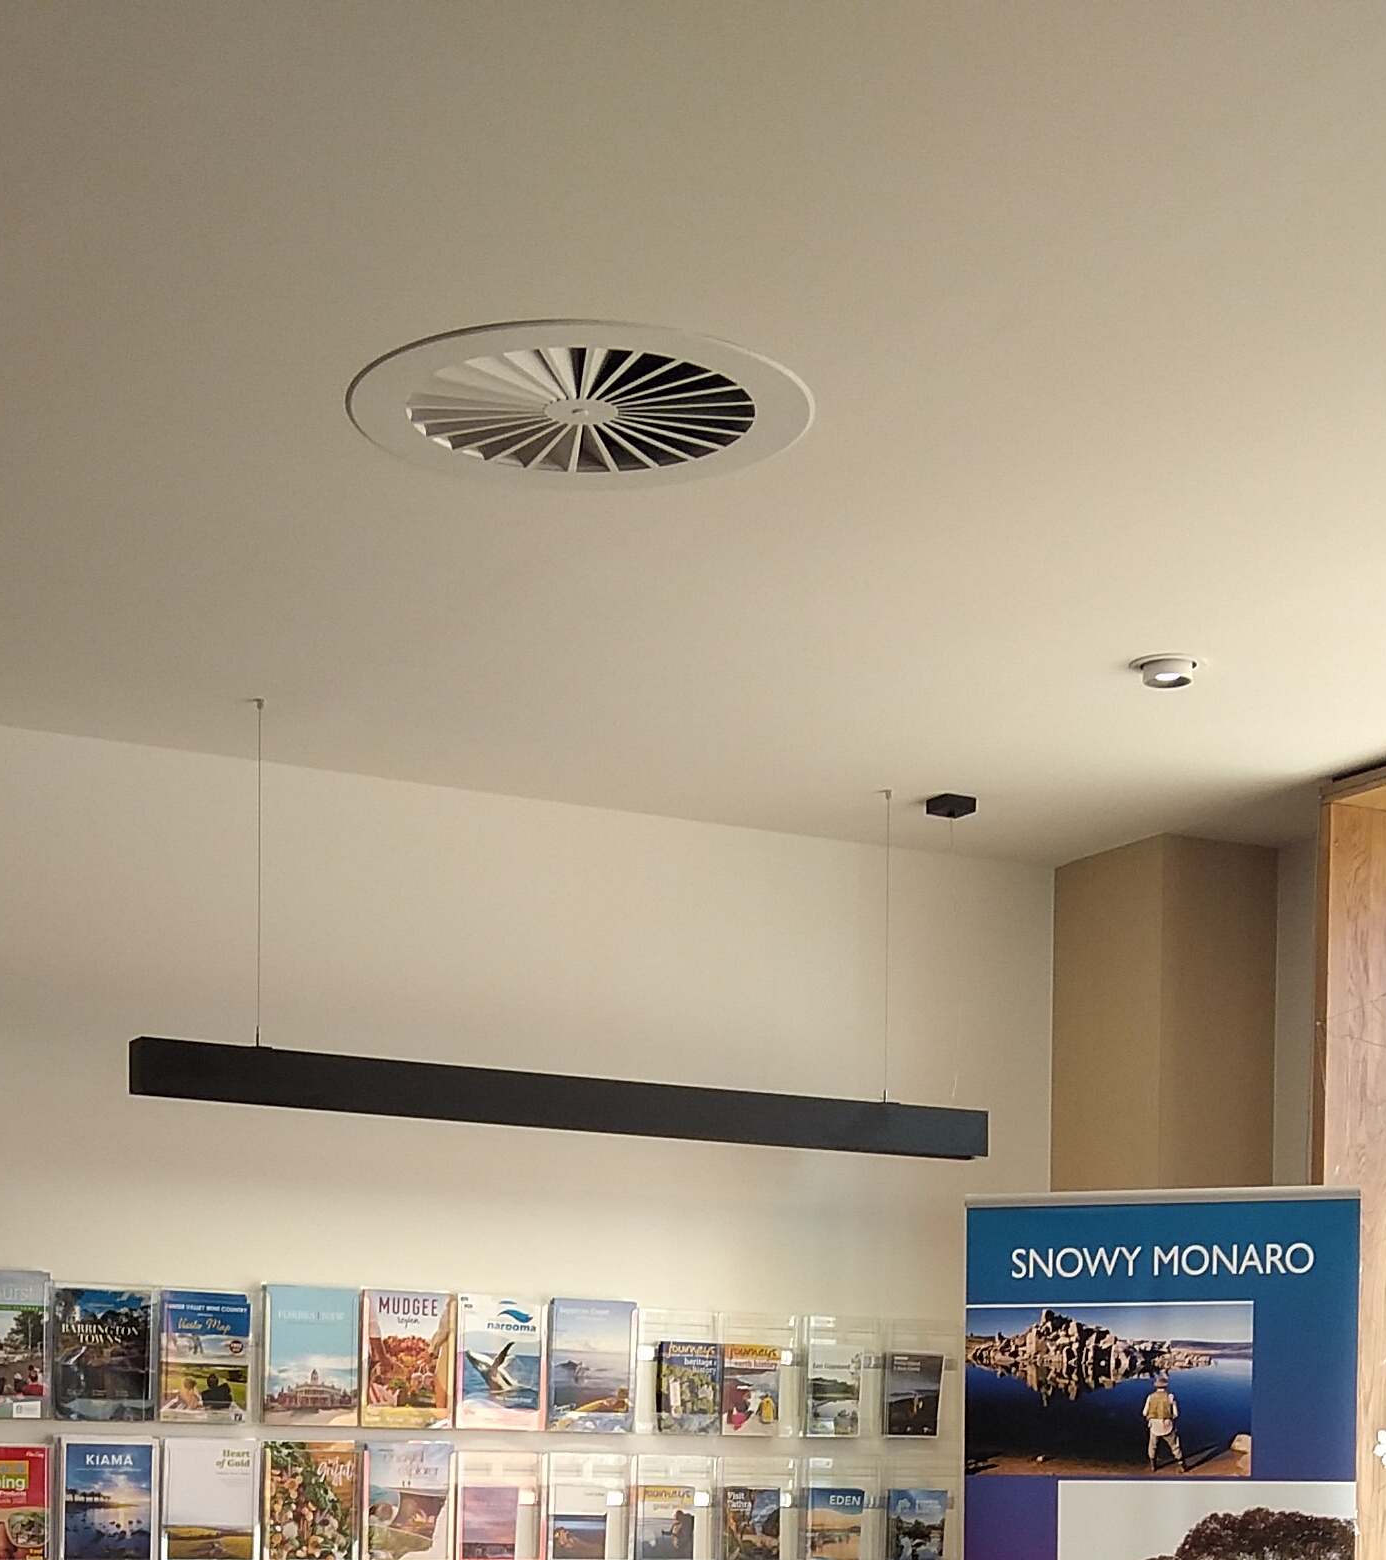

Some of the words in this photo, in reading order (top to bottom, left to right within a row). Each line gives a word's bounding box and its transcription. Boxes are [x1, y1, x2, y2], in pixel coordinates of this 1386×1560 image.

[1010, 1245, 1143, 1279] SNOWY
[1153, 1242, 1315, 1276] MONARO
[378, 1296, 439, 1317] MUDGEE
[61, 1323, 140, 1337] BARRINGTON
[206, 1317, 232, 1335] Map
[487, 1321, 537, 1333] narooma
[79, 1334, 122, 1345] TOWNS
[85, 1454, 134, 1466] KIAMA
[222, 1450, 250, 1458] Heart
[215, 1458, 226, 1469] of
[227, 1459, 250, 1468] Gold
[829, 1495, 861, 1506] EDEN
